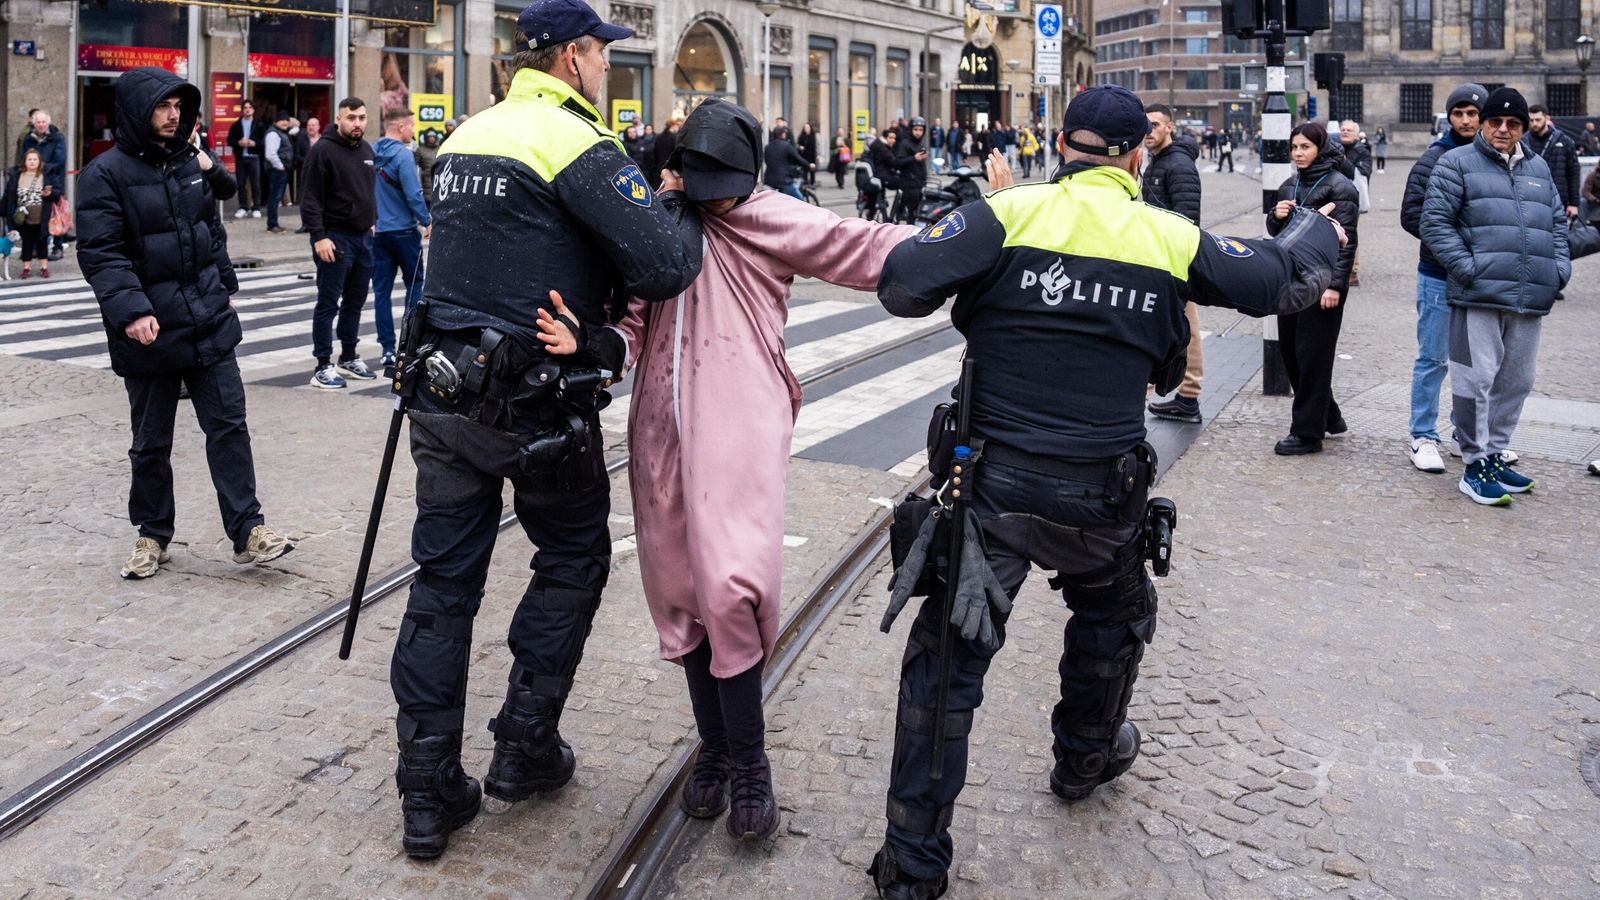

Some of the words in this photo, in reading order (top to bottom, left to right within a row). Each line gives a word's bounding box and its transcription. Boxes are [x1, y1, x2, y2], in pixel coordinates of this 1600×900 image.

[96, 50, 136, 59] DISCOVER
[142, 52, 171, 60] WORLD
[420, 107, 443, 120] €50
[432, 166, 507, 201] POLITIE
[1020, 264, 1158, 313] POLITIE
